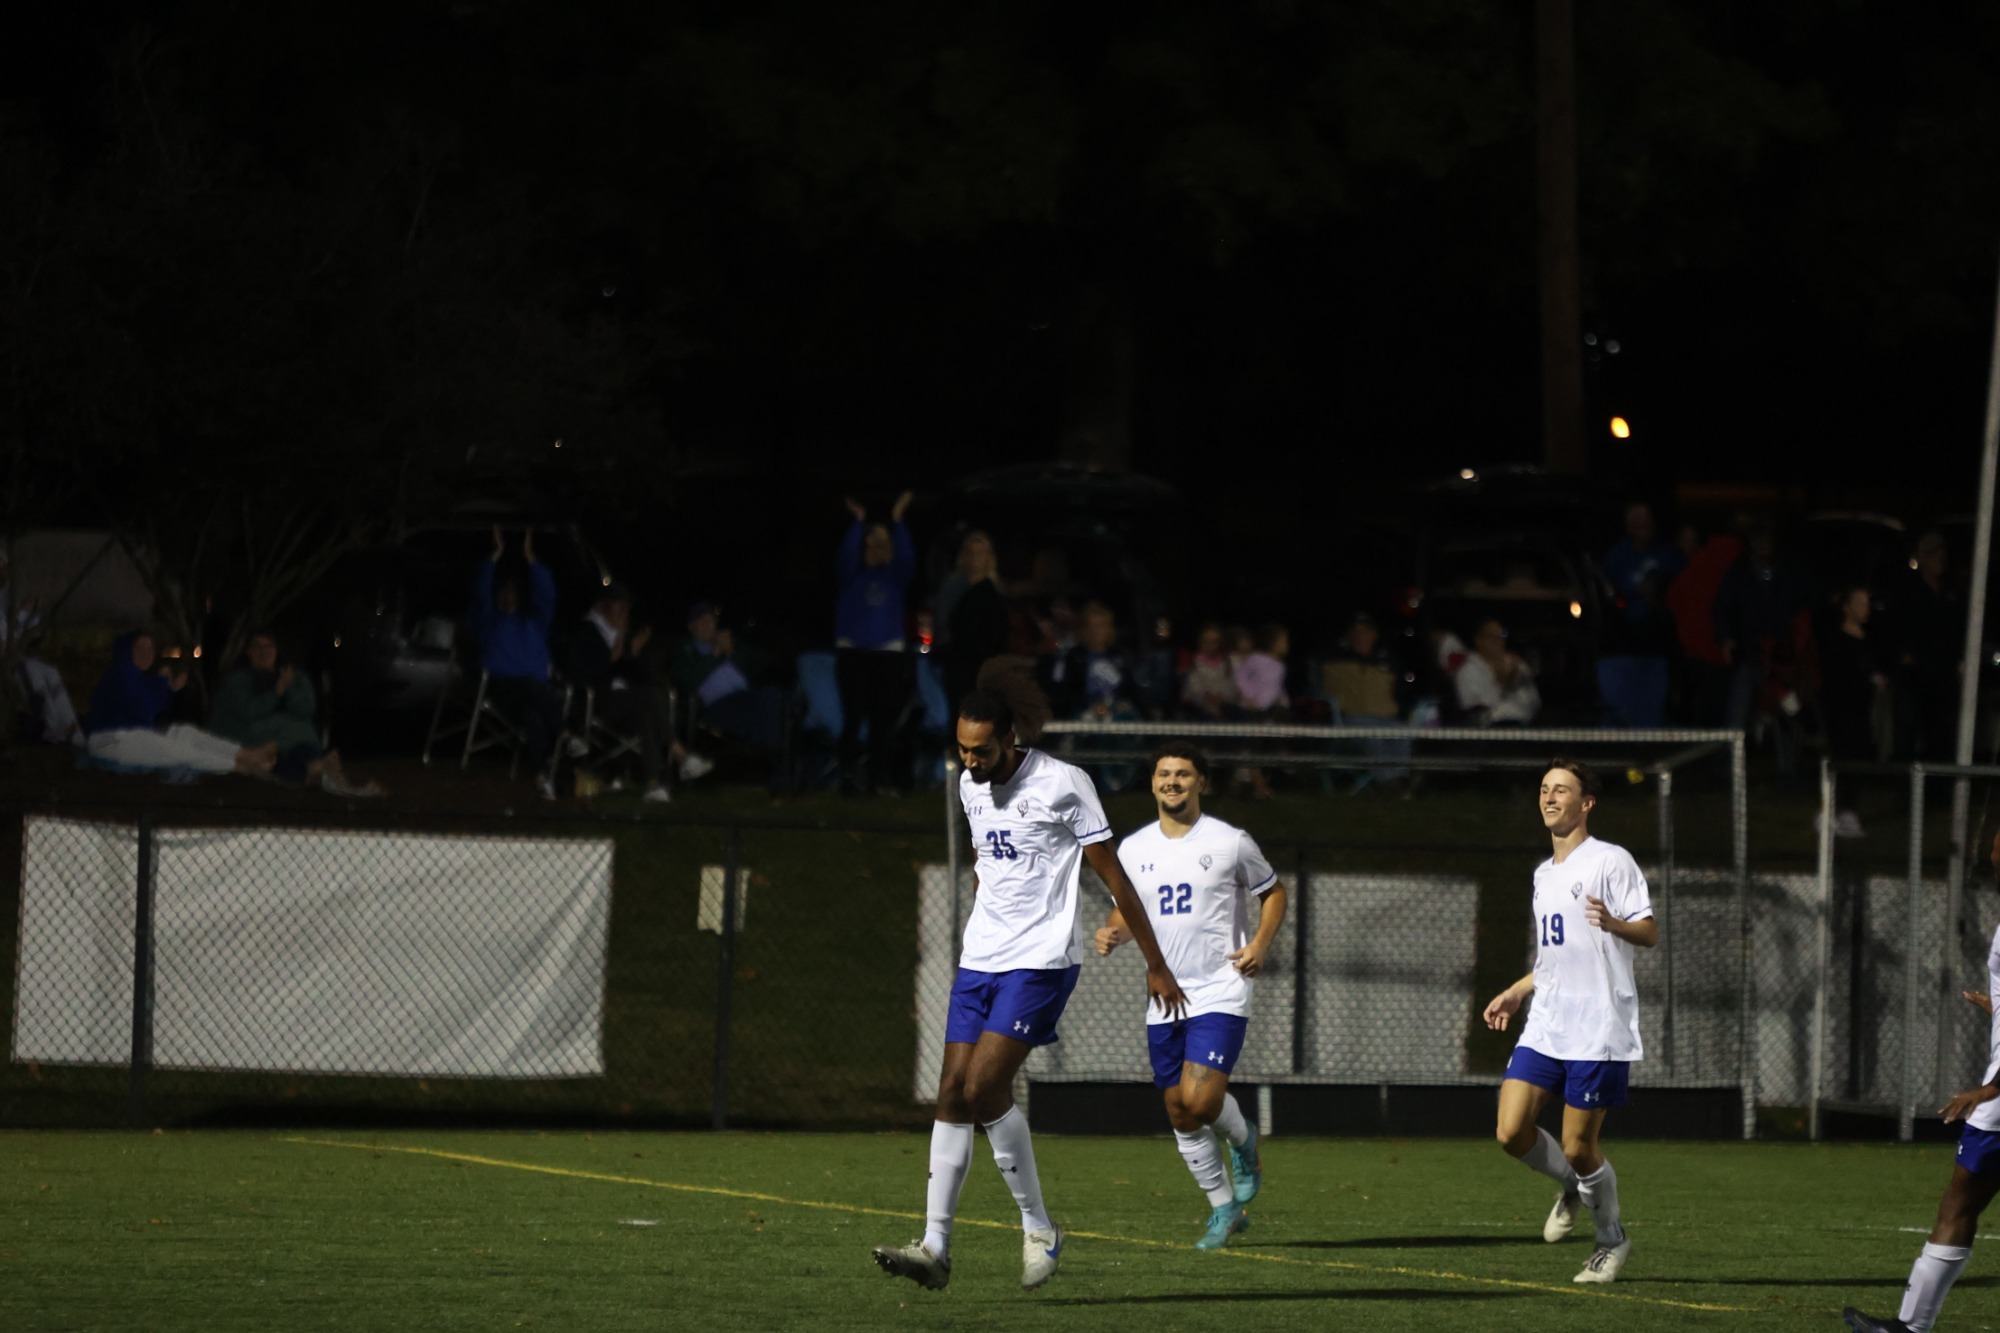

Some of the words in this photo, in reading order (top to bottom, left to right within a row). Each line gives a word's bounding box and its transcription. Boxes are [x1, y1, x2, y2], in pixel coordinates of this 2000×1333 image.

[986, 830, 1018, 860] 35
[1158, 883, 1192, 915] 22
[1542, 913, 1565, 946] 19
